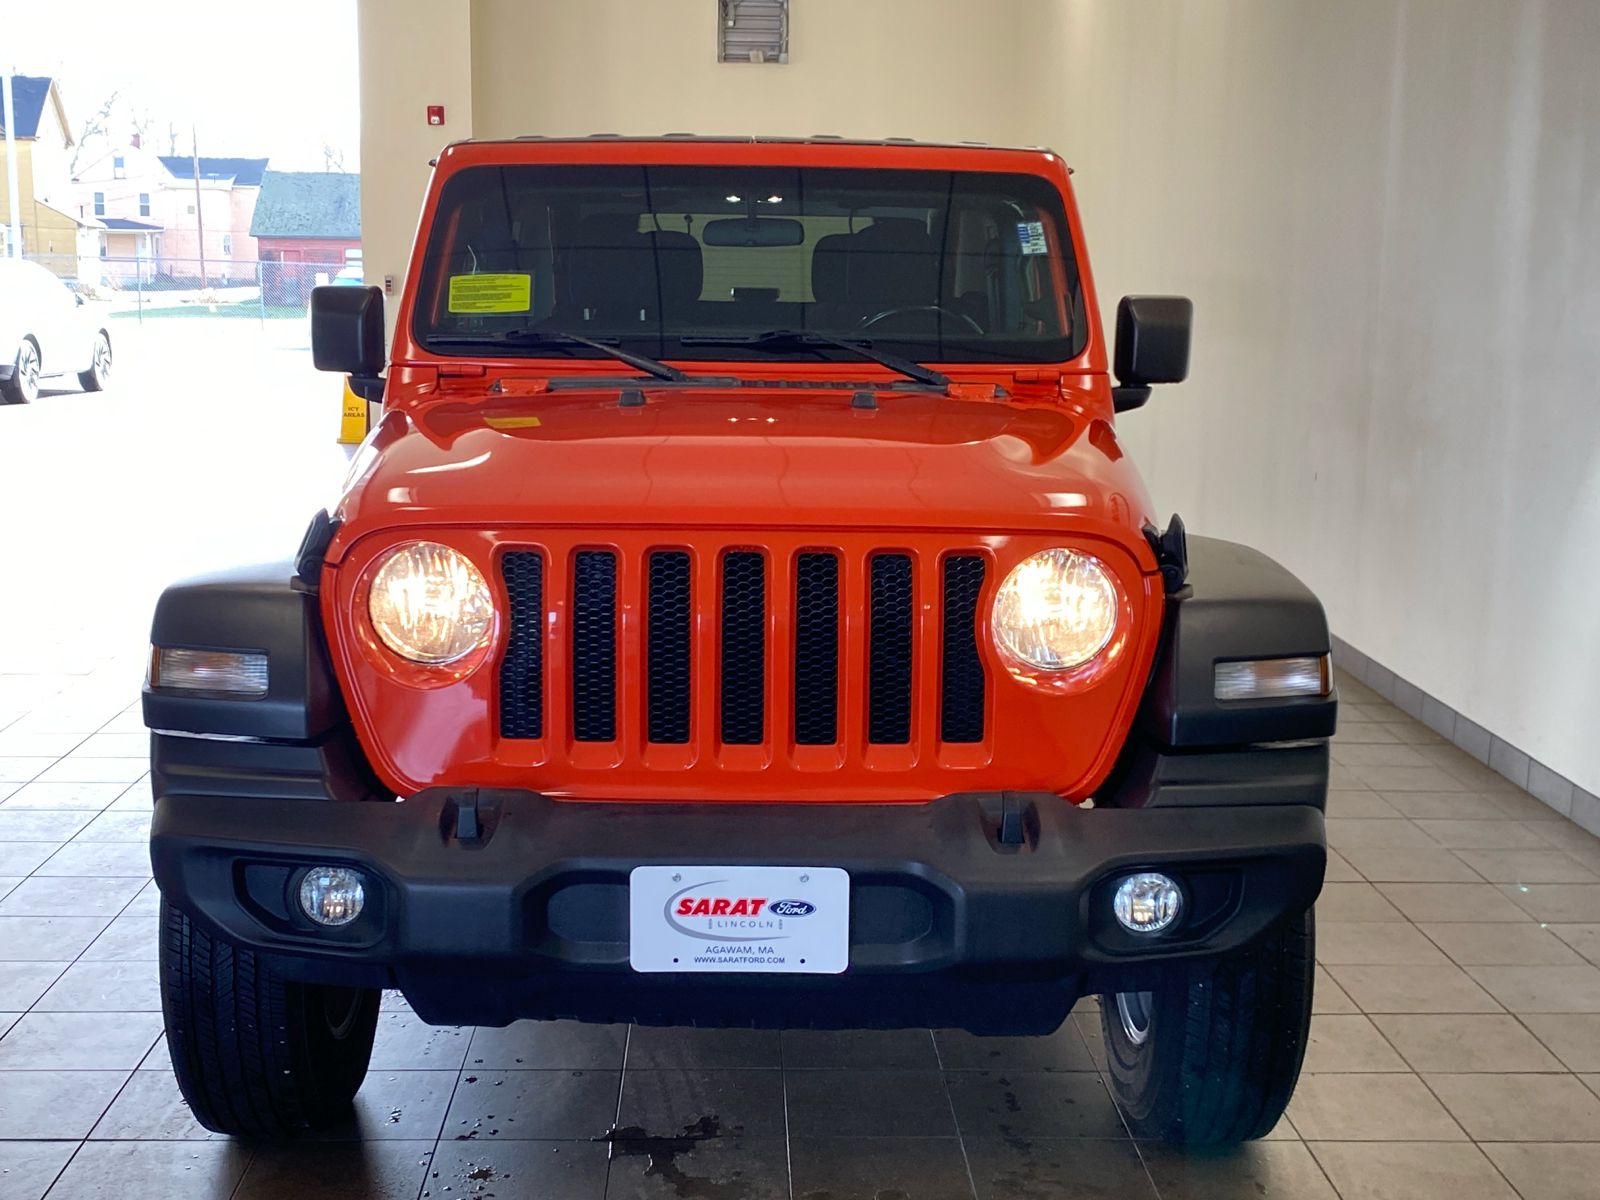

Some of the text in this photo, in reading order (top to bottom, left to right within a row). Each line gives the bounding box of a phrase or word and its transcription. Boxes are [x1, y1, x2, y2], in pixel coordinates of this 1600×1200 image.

[675, 897, 768, 916] SARAT
[717, 920, 773, 928] LINCOLN
[705, 946, 774, 955] AGAWAM, MA
